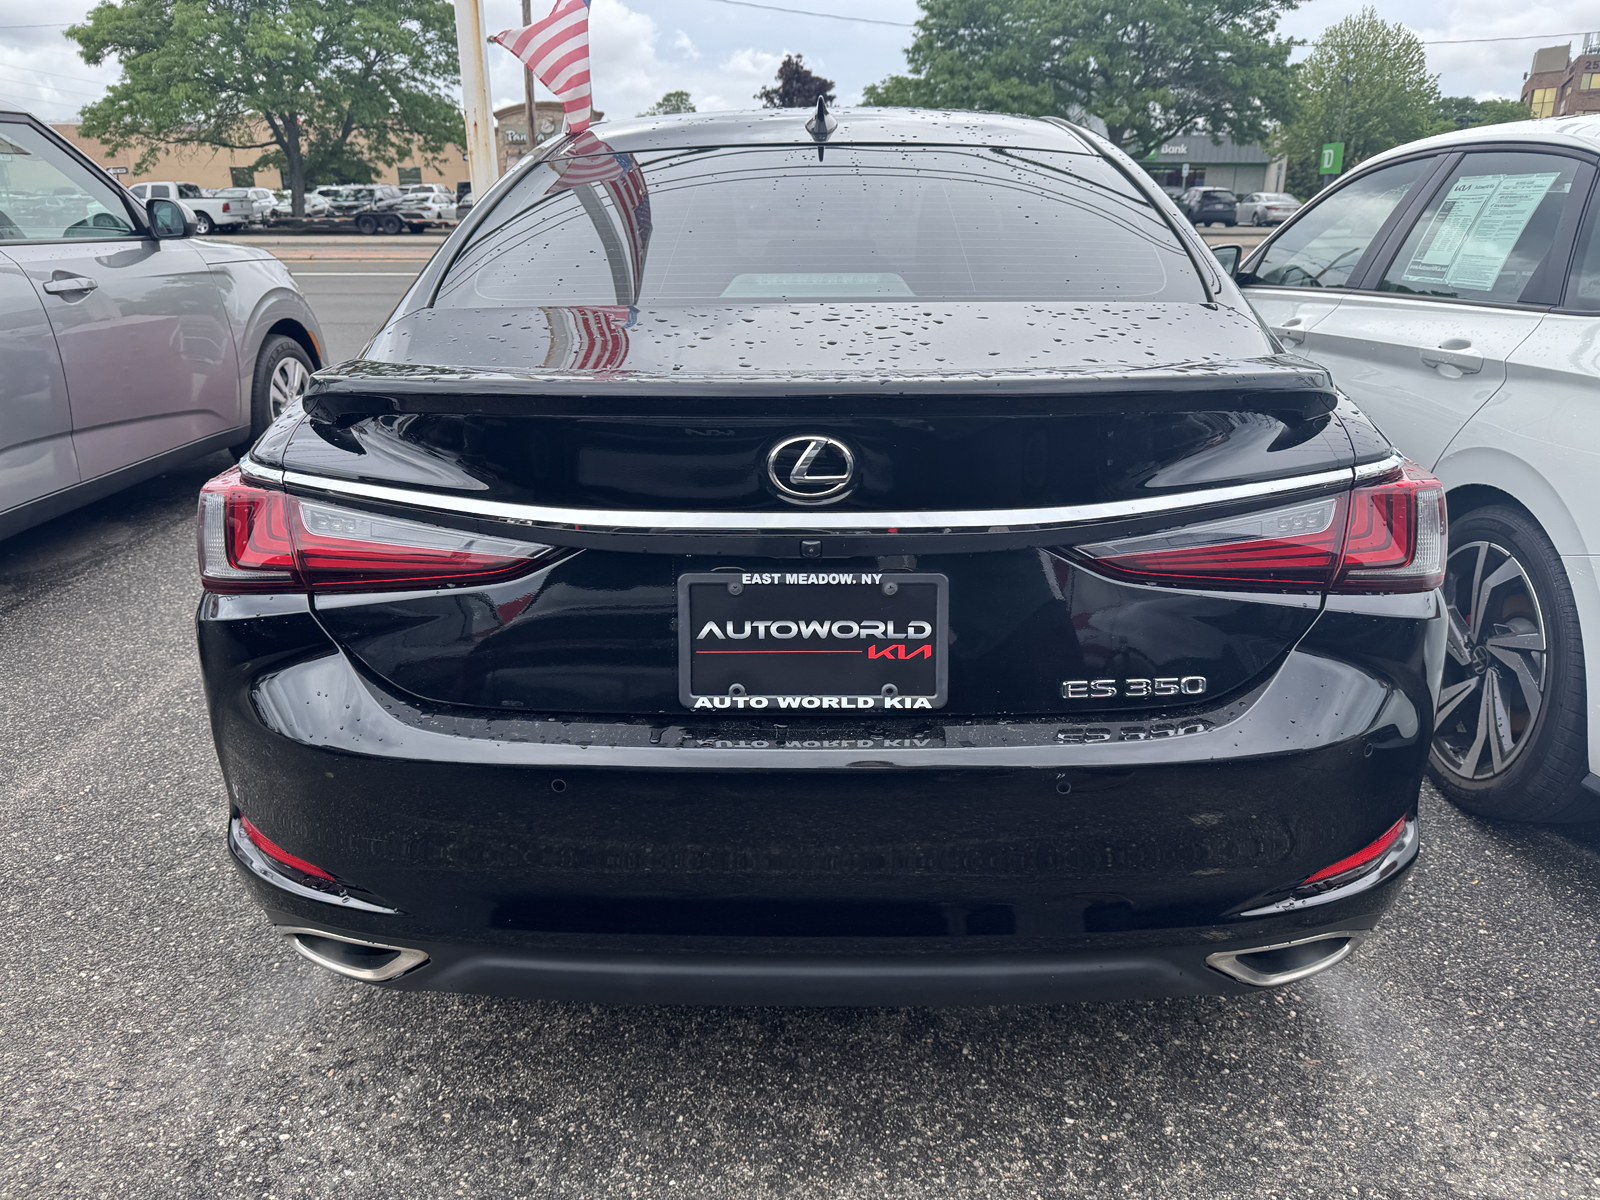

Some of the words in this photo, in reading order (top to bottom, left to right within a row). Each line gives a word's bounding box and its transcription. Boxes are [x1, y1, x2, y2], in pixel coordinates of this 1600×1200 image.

[506, 130, 545, 142] Pana
[1161, 143, 1188, 154] Bank
[742, 573, 781, 585] EAST
[861, 573, 883, 585] NY
[696, 620, 933, 640] AUTOWORLD
[867, 644, 933, 660] KIA
[1062, 679, 1118, 699] ES
[1125, 676, 1207, 697] 350
[694, 696, 769, 709] AUTO
[777, 696, 875, 709] WORLD
[884, 696, 933, 709] KIA
